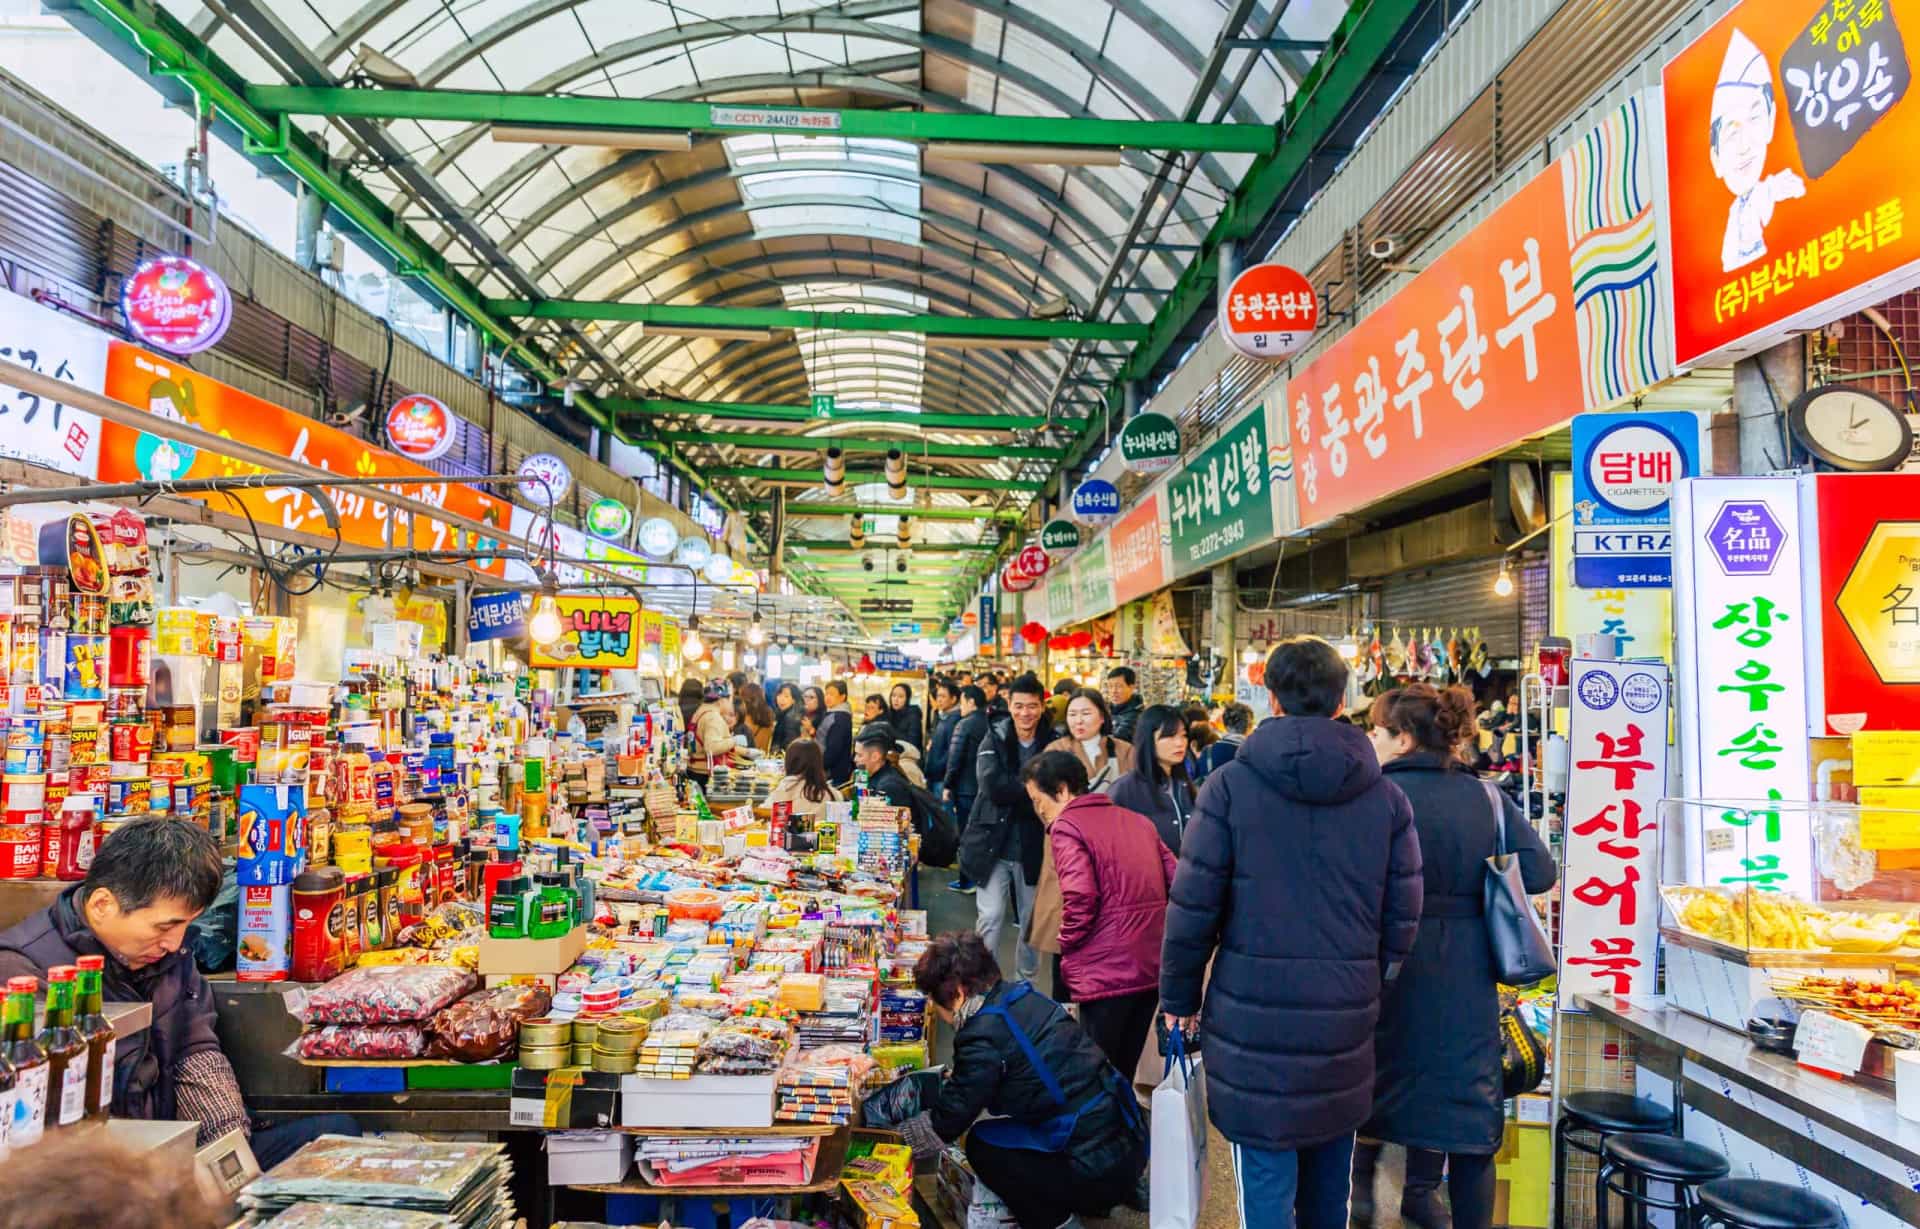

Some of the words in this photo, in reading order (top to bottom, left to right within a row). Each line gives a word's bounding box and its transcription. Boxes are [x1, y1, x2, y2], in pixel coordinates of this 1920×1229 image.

[1785, 41, 1895, 131] 장우손
[735, 113, 764, 123] CCTV
[1714, 198, 1904, 323] (주)부산세광식품
[1230, 290, 1315, 322] 동관주단부
[1319, 237, 1557, 478] 동관주단부
[1124, 429, 1178, 455] 누나네신발
[1296, 392, 1318, 505] 광장
[1599, 451, 1673, 485] 담배
[1171, 425, 1263, 537] 누나네신발
[1606, 486, 1666, 498] CIGARETTES
[1721, 526, 1771, 551] 名品
[1566, 723, 1659, 995] 부산어묵
